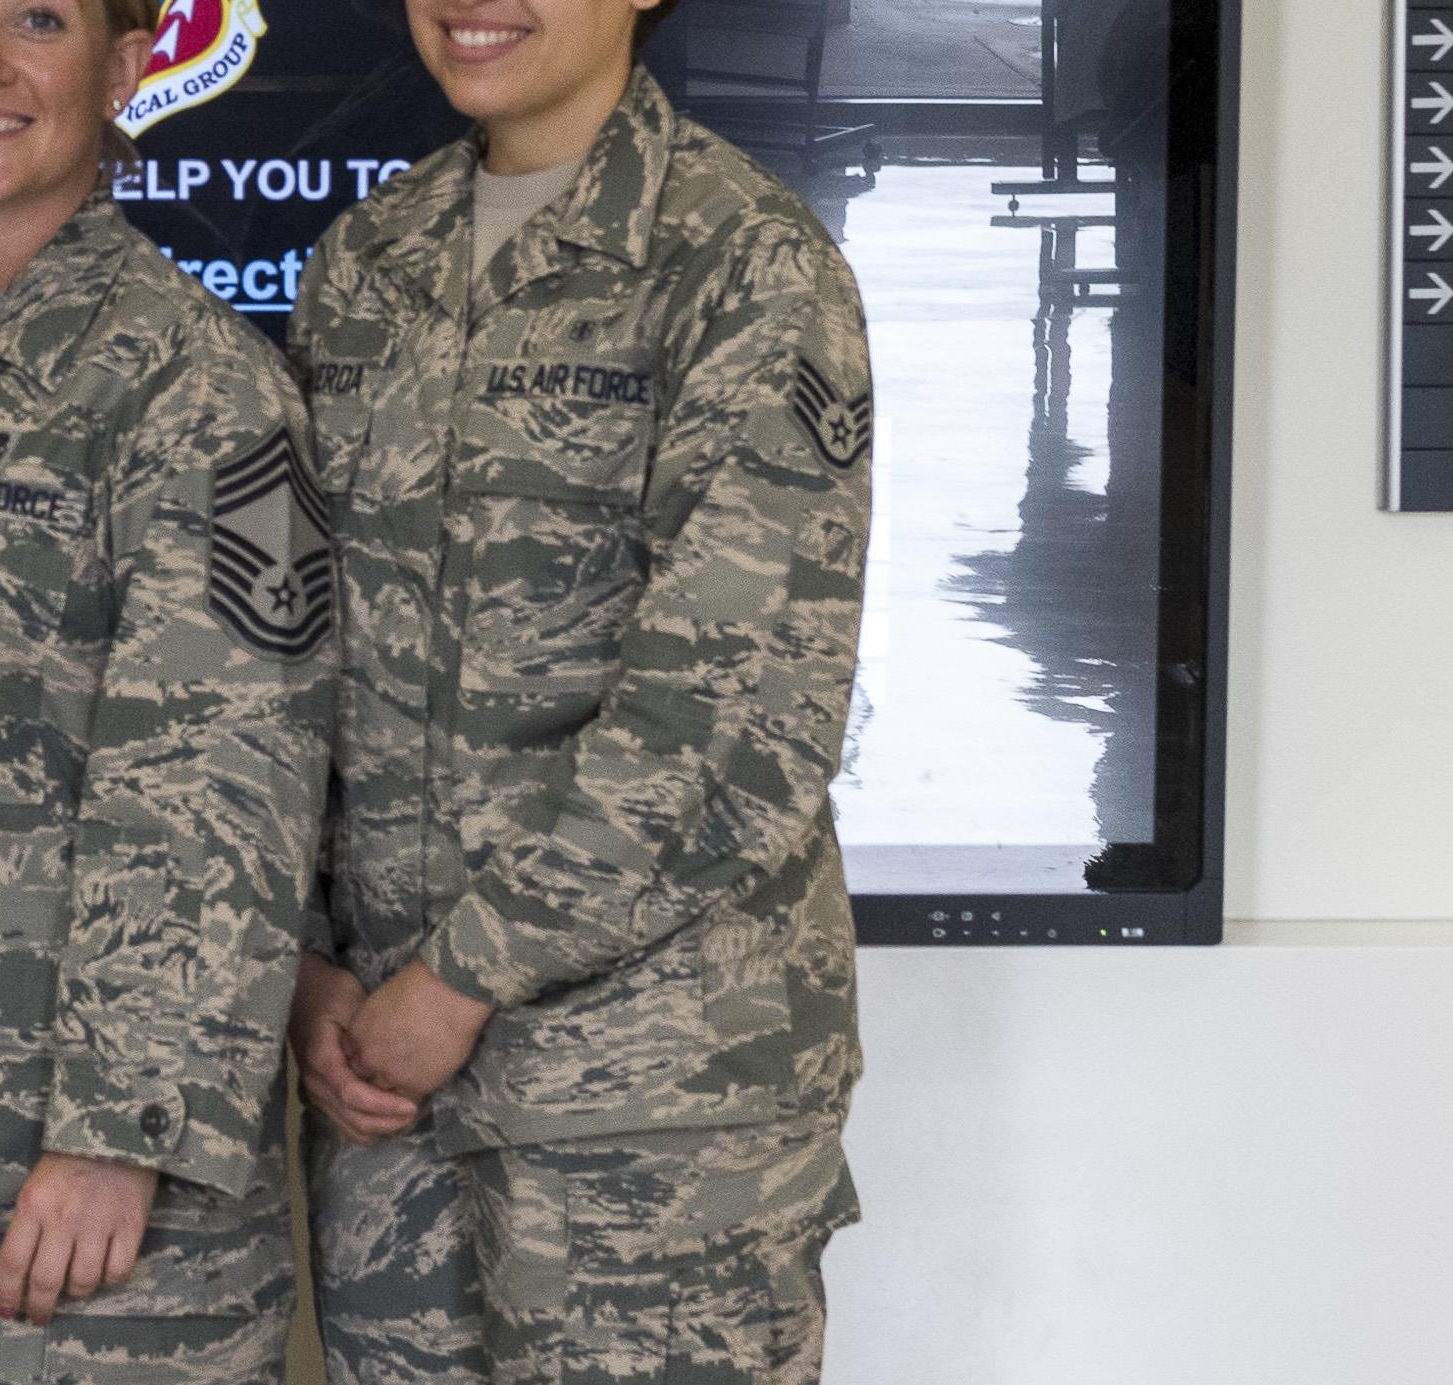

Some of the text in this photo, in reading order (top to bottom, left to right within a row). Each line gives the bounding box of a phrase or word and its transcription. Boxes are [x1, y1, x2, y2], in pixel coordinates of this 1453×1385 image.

[182, 31, 249, 97] GROUP
[221, 159, 330, 200] YOU
[529, 363, 569, 394] AIR
[572, 364, 652, 405] FORCE
